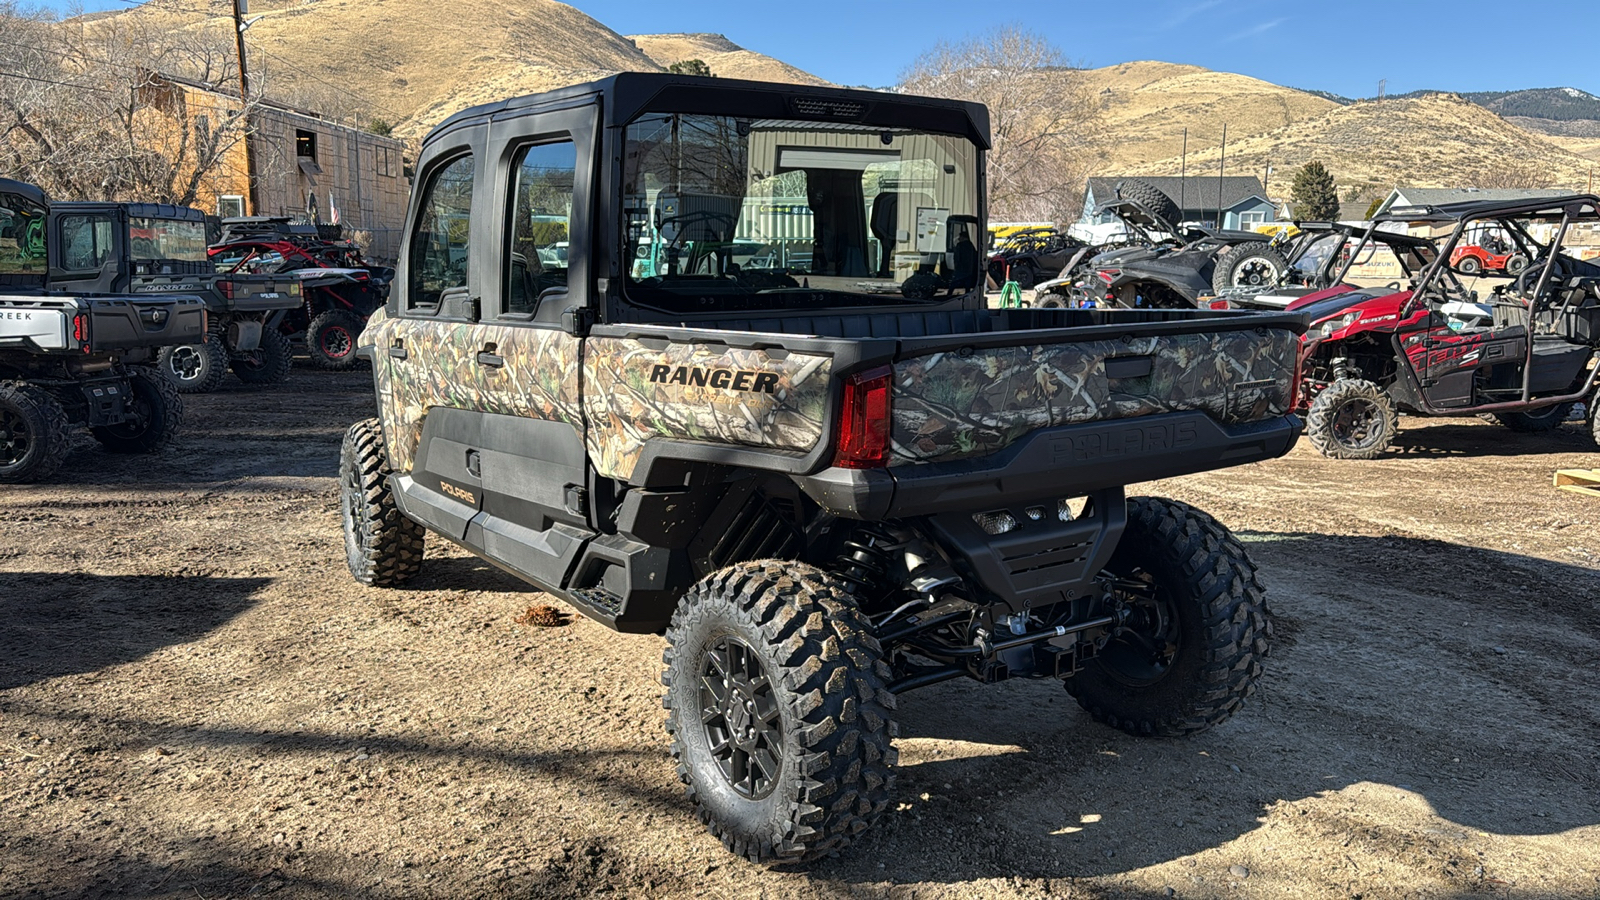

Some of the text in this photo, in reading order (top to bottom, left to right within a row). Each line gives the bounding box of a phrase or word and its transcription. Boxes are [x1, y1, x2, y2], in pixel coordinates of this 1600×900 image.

[649, 364, 780, 394] RANGER
[1050, 421, 1198, 464] POLARIS
[440, 480, 475, 504] POLARIS
[682, 685, 701, 746] CROSS
